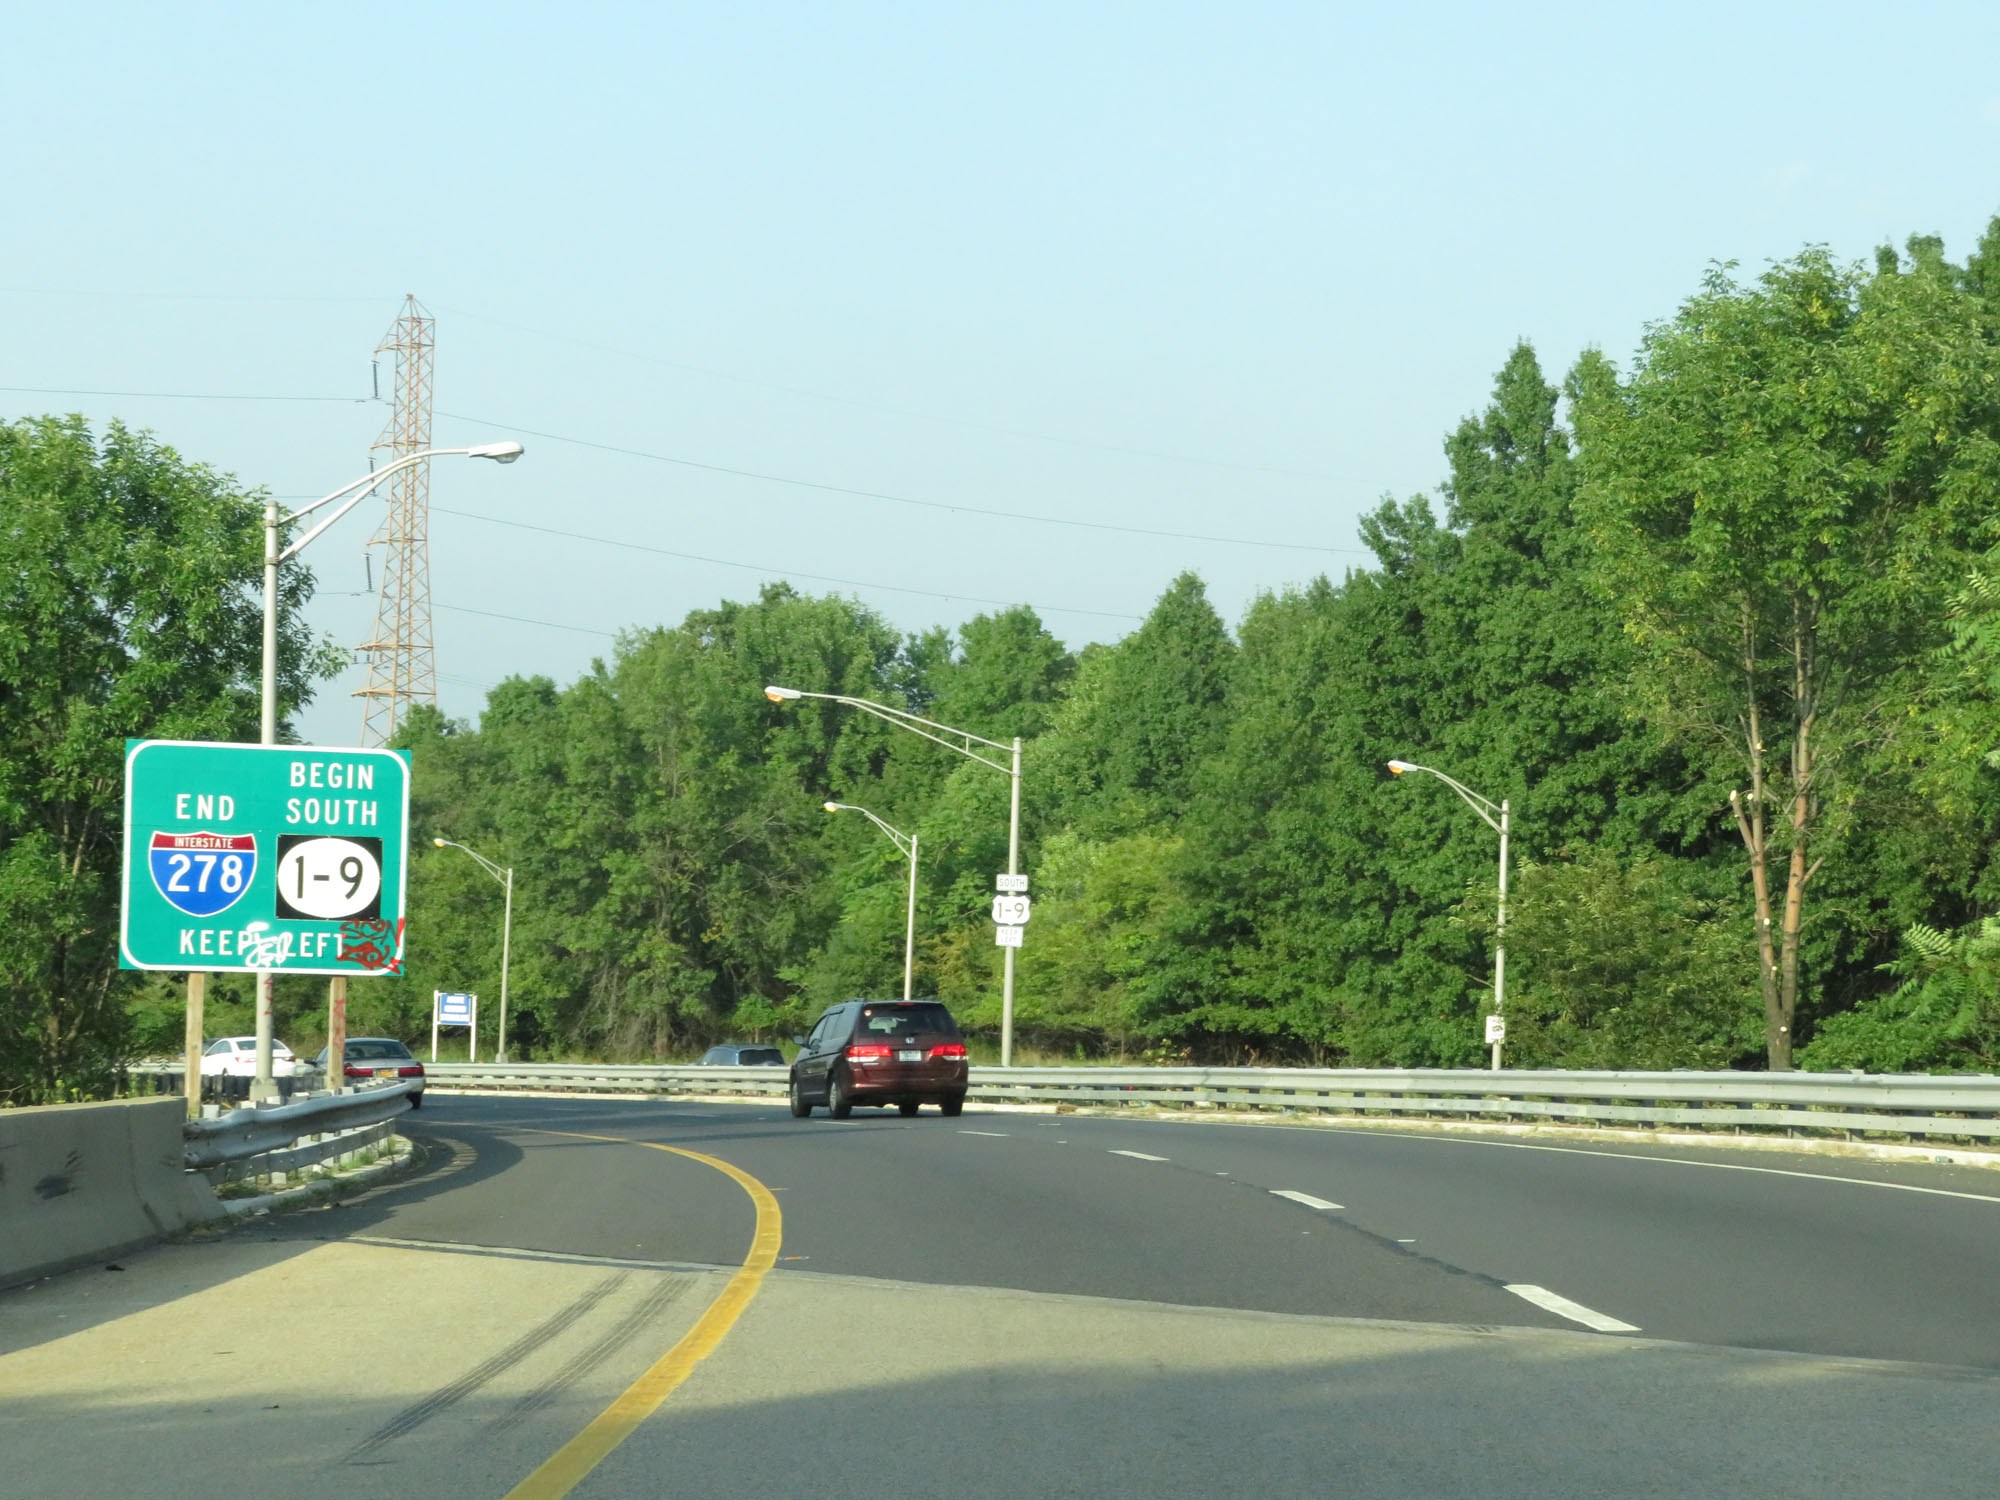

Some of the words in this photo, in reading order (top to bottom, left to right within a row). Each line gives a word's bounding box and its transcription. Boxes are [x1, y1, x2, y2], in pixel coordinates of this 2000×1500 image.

[290, 761, 374, 790] BEGIN
[176, 793, 235, 821] END
[285, 798, 378, 826] SOUTH
[174, 836, 234, 849] INTERSTATE
[167, 853, 243, 894] 278
[295, 855, 364, 900] 1-9
[999, 878, 1025, 888] SOUTH
[998, 902, 1025, 919] 1-9
[179, 928, 252, 956] KEEP
